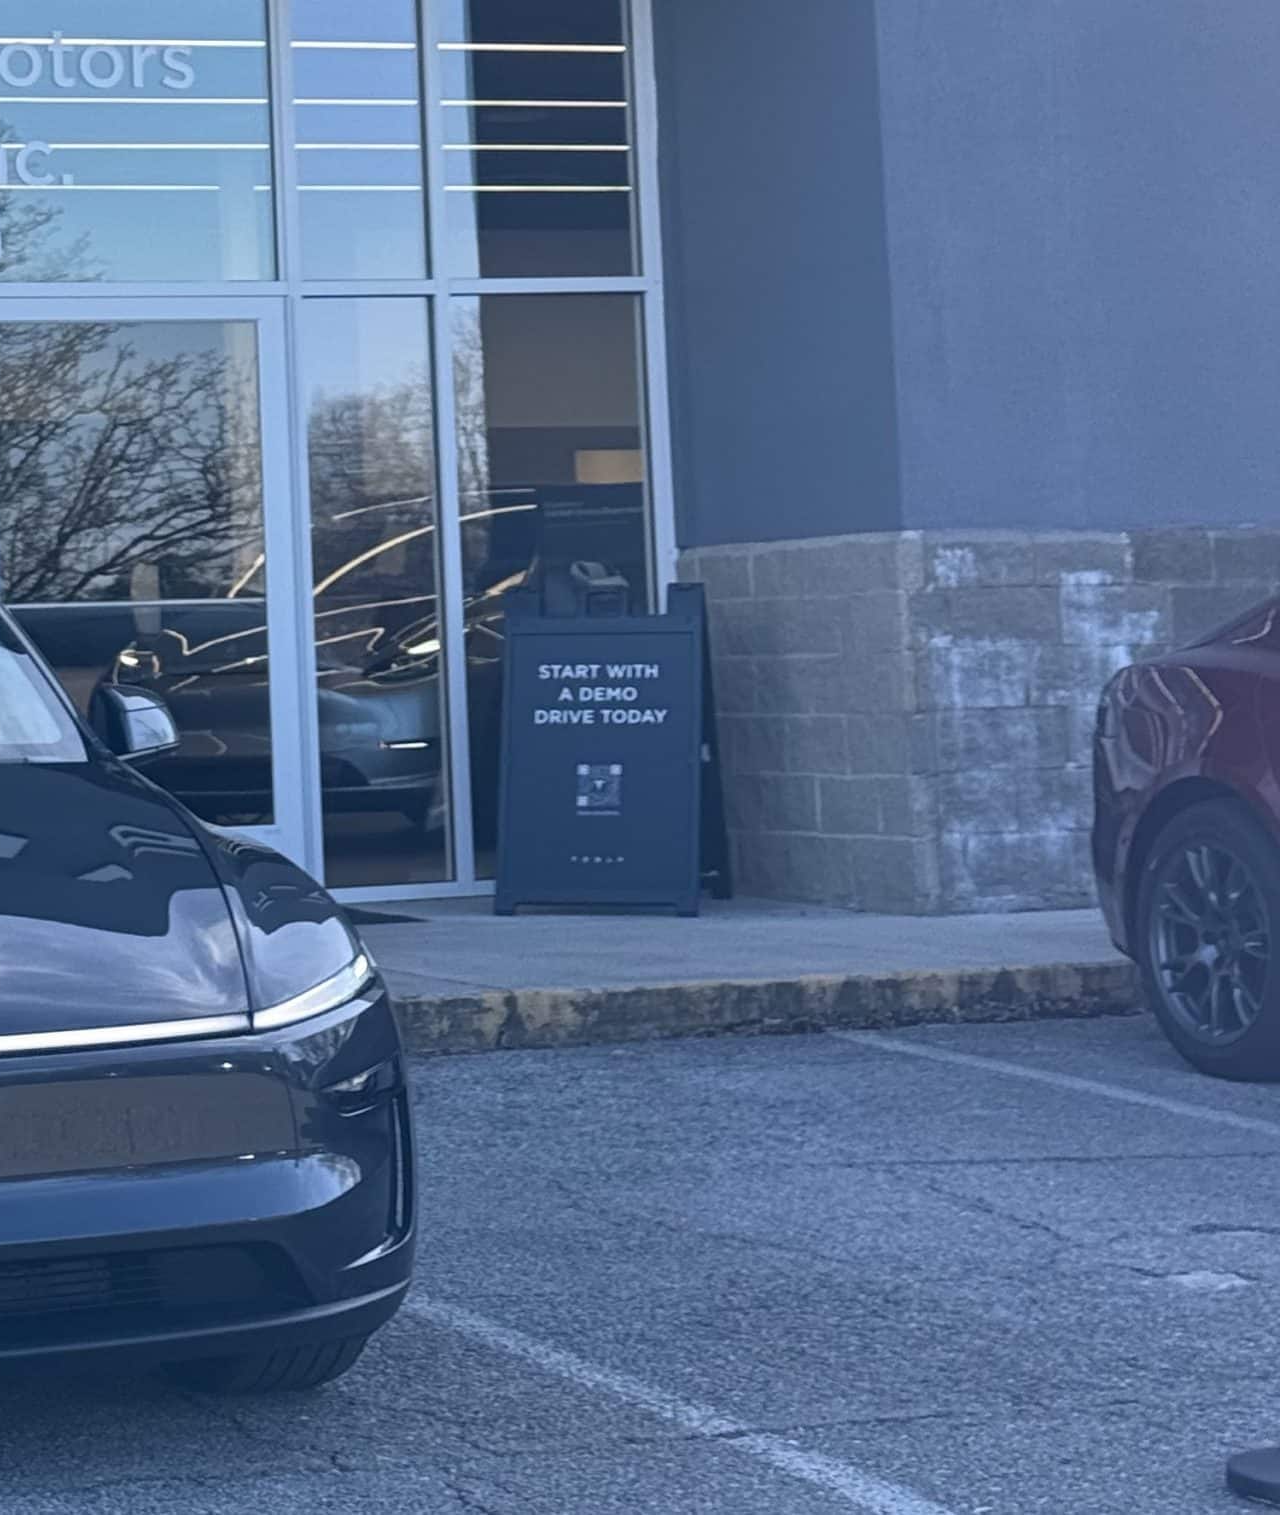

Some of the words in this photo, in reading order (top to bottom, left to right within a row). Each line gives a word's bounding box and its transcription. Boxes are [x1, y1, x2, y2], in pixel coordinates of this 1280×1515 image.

[538, 664, 600, 679] START
[606, 664, 659, 679] WITH
[558, 687, 574, 701] A
[579, 687, 638, 701] DEMO
[534, 709, 595, 724] DRIVE
[601, 709, 668, 724] TODAY
